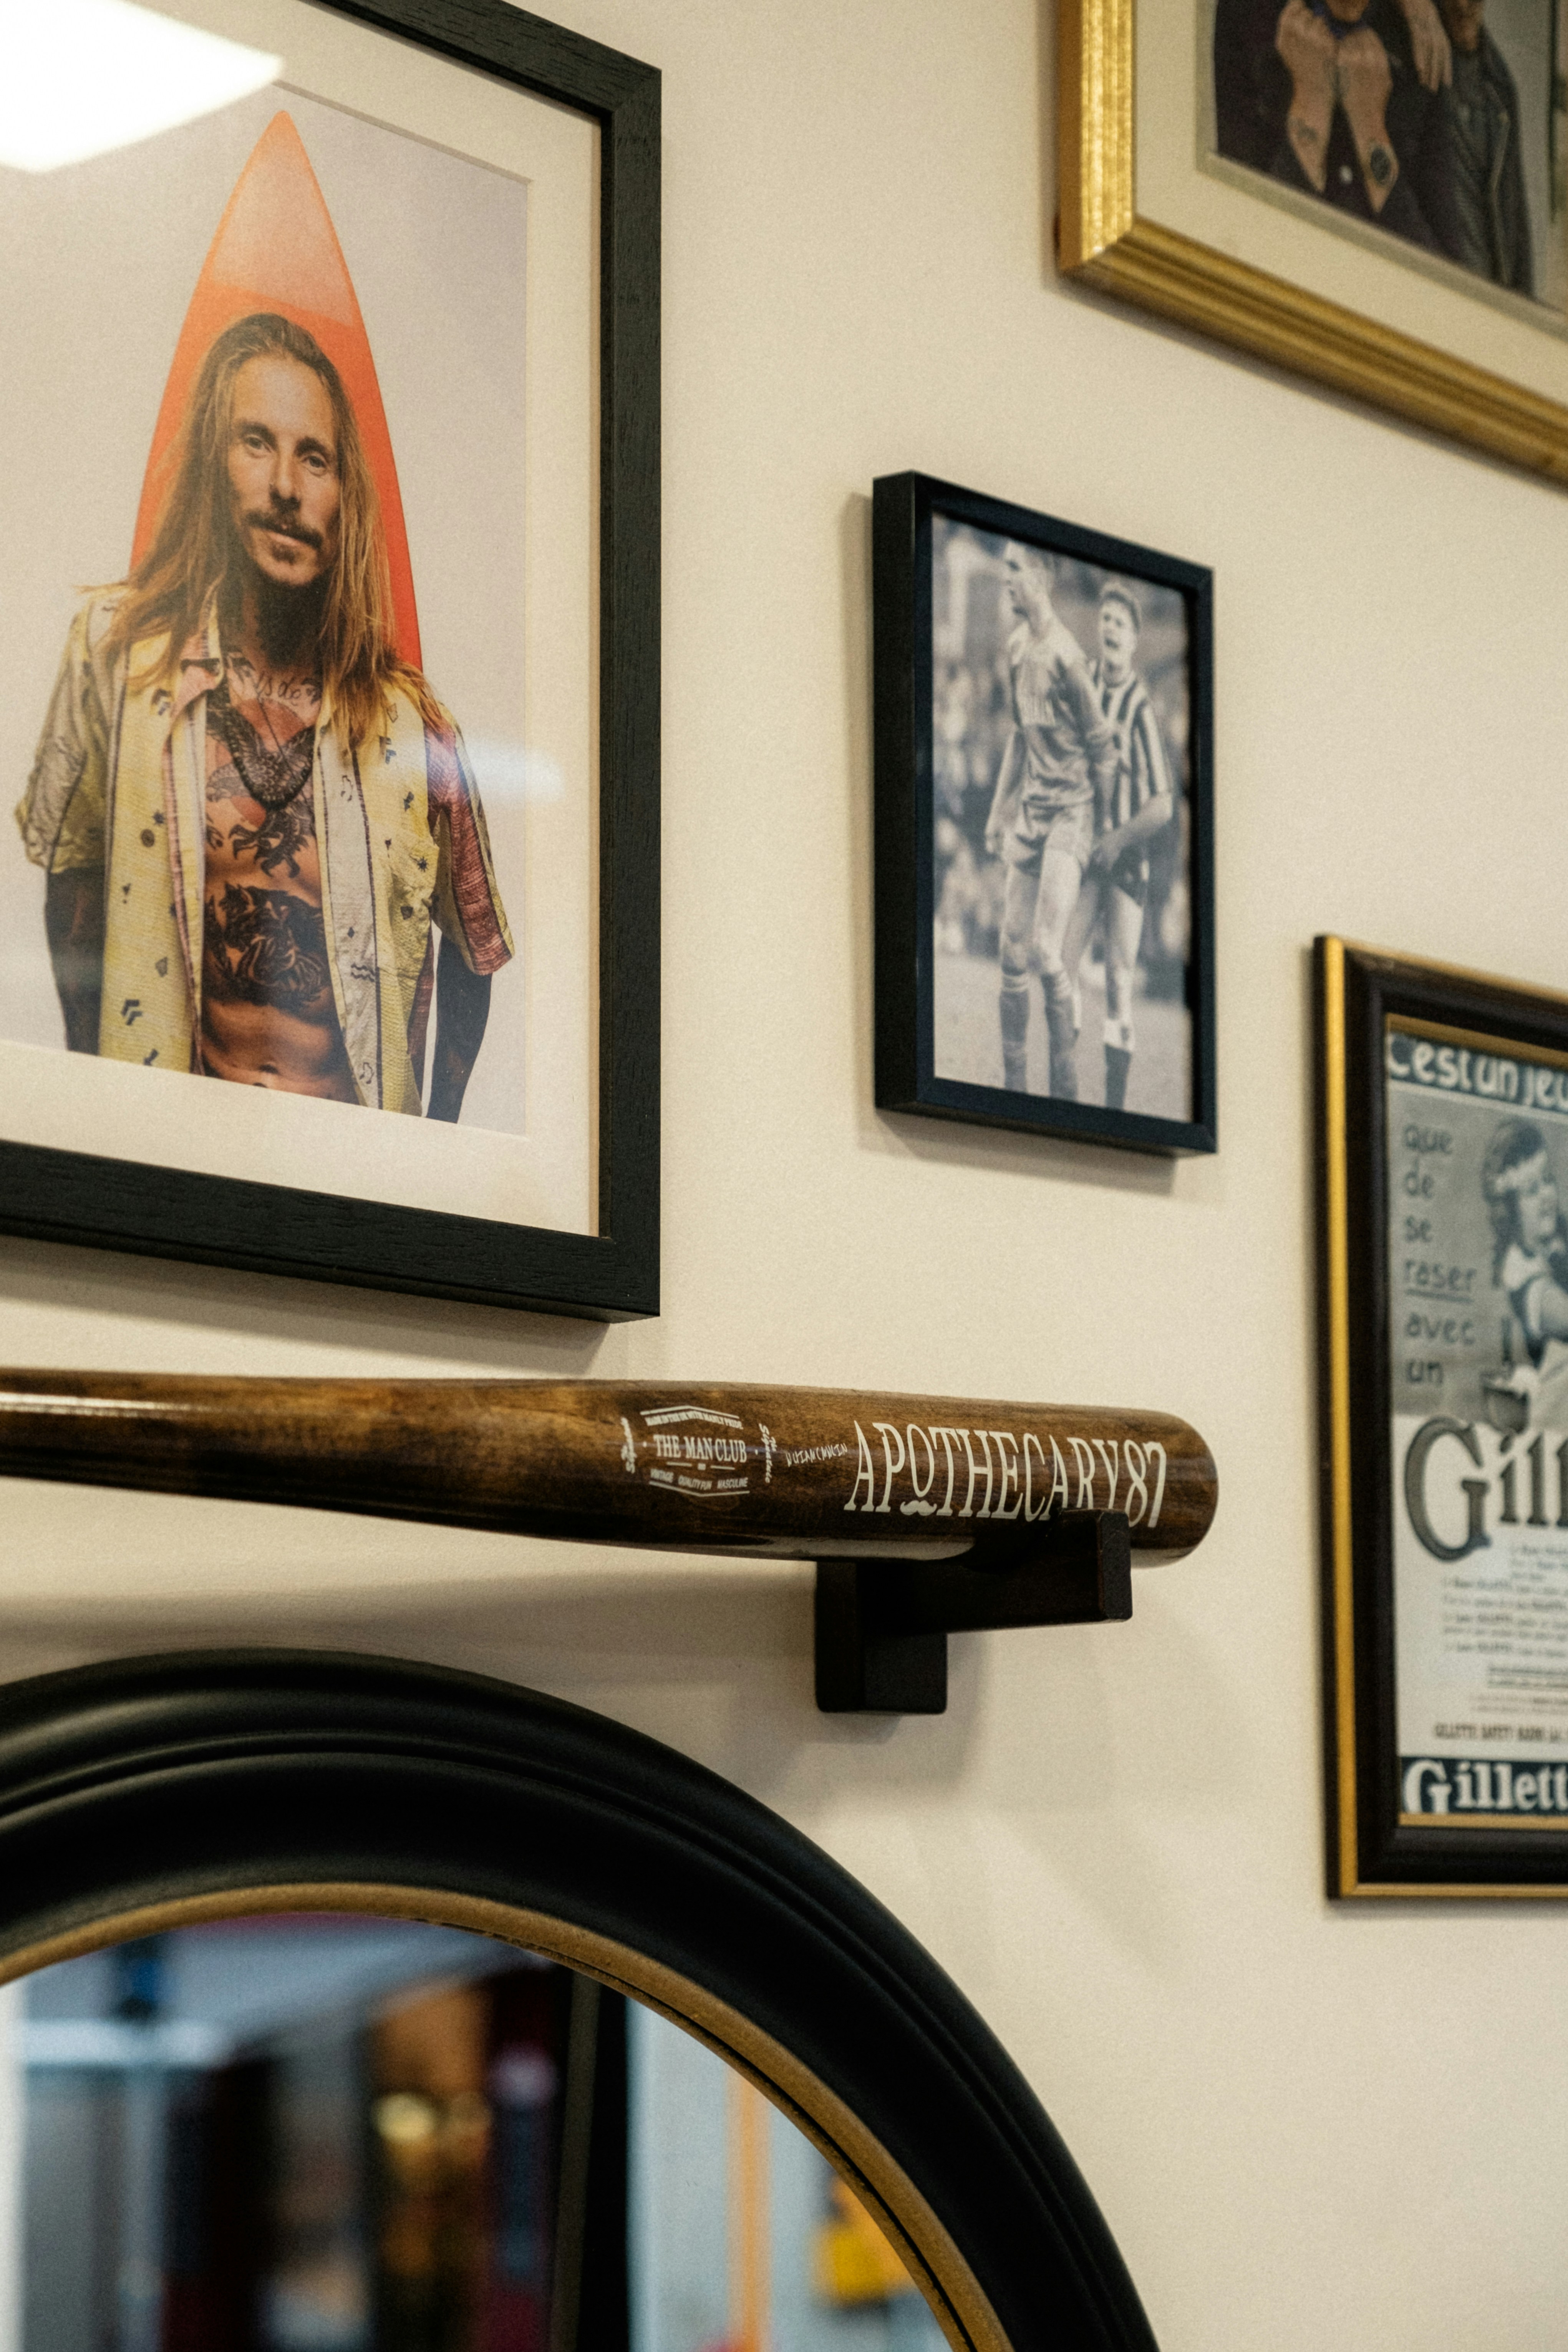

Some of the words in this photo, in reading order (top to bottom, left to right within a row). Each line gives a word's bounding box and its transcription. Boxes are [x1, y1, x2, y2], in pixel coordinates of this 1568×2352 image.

[1404, 1156, 1434, 1199] de
[1404, 1259, 1477, 1291] raser
[1404, 1312, 1476, 1345] avec
[1407, 1359, 1443, 1385] un
[653, 1434, 681, 1458] THE
[683, 1436, 713, 1460] MAN
[715, 1438, 747, 1463] CLUB
[843, 1420, 1167, 1528] APOTHECARY87
